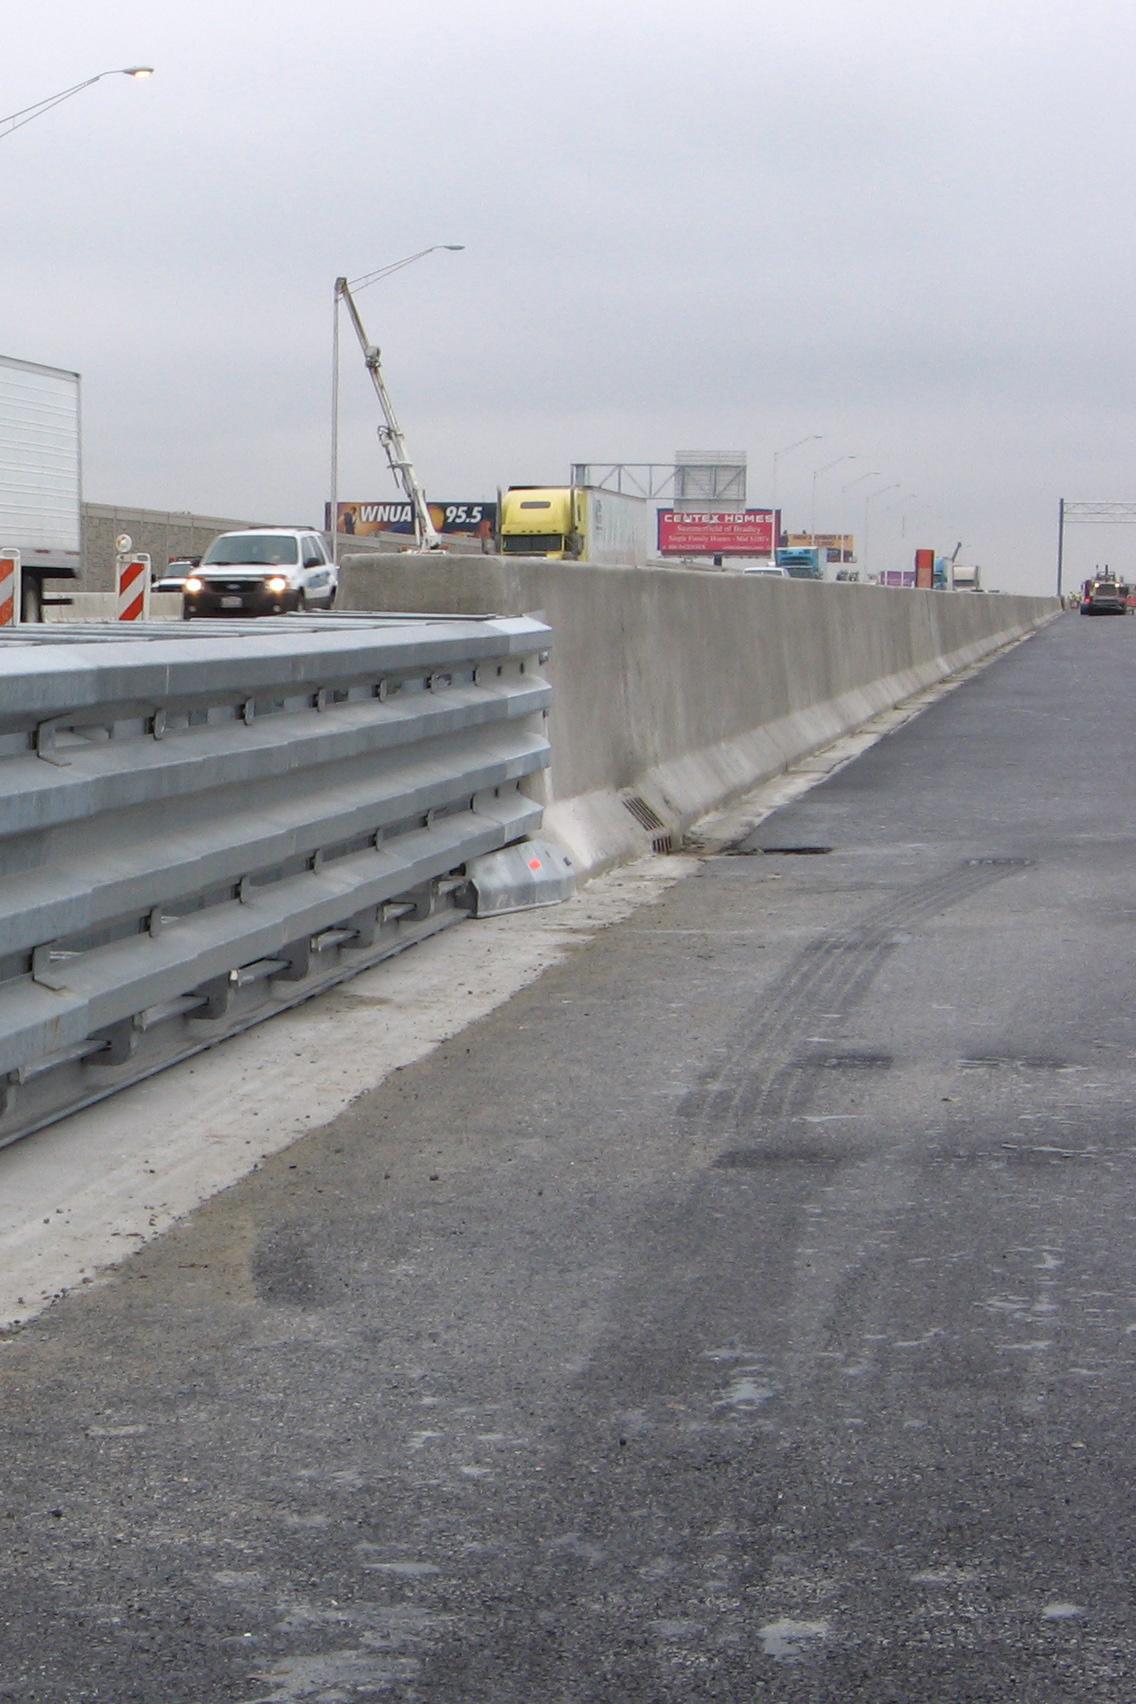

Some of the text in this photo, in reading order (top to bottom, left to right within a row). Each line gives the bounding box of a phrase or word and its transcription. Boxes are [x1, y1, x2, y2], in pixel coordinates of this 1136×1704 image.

[361, 505, 482, 523] WNUA 95.5
[664, 514, 774, 523] CENTEX HOMES
